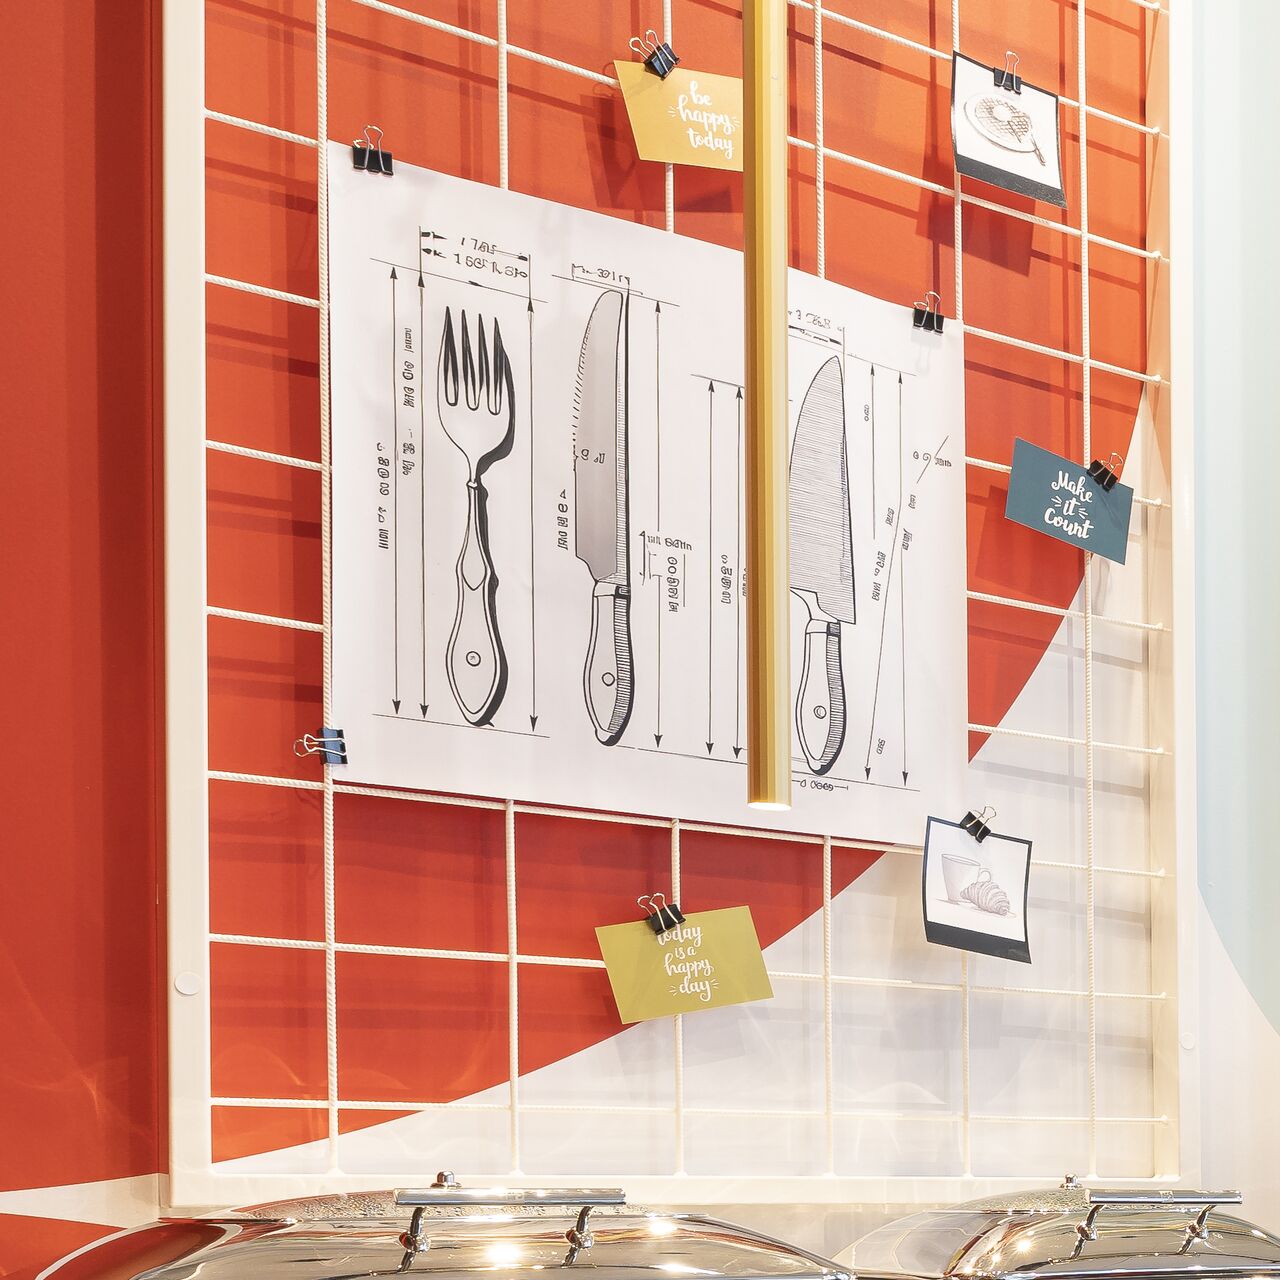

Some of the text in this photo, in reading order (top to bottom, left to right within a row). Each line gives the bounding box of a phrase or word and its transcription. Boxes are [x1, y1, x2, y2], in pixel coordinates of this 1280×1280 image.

[690, 80, 713, 106] be
[677, 94, 736, 135] happy
[686, 127, 733, 160] today
[1050, 470, 1093, 503] Make
[1062, 497, 1081, 516] it
[1044, 507, 1094, 539] Count
[664, 952, 715, 979] happy
[674, 946, 697, 960] is a
[679, 975, 711, 1002] day
